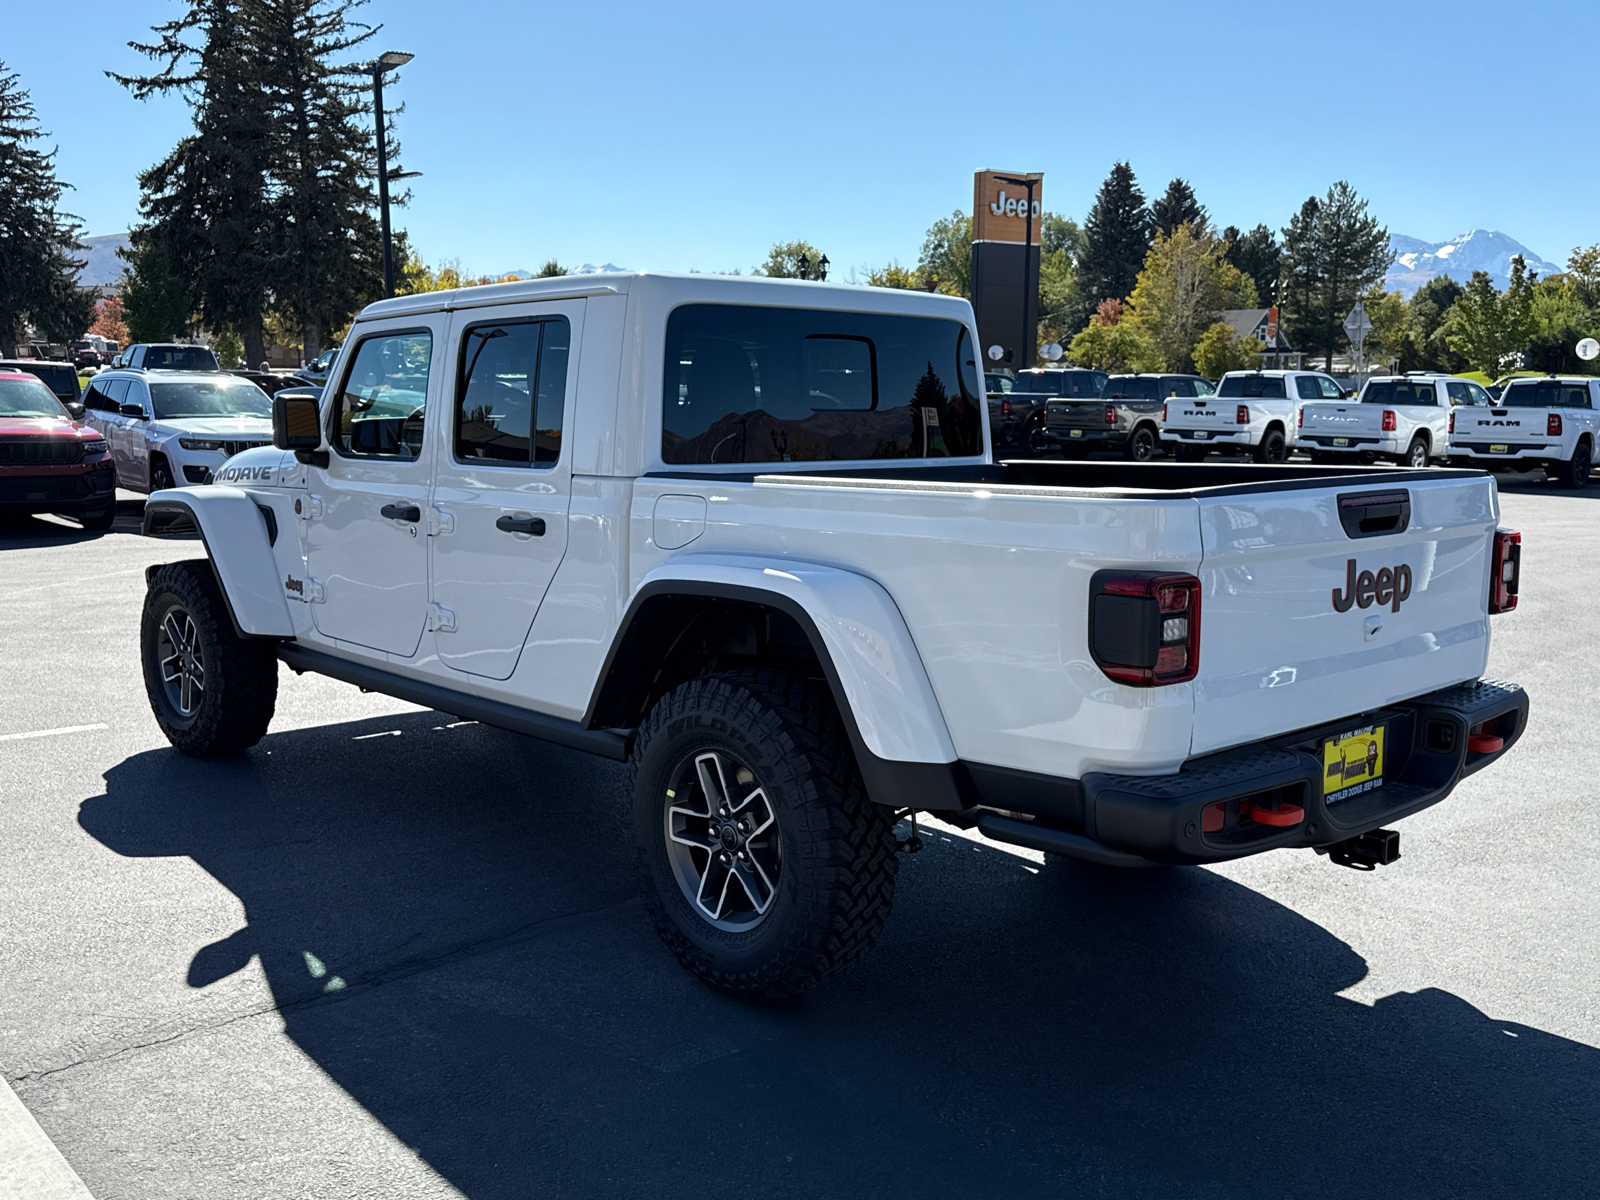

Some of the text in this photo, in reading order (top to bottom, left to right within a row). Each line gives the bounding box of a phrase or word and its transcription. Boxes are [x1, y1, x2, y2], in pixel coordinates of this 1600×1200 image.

[990, 190, 1040, 219] Jeep
[215, 466, 272, 483] MOJAVE
[1332, 558, 1412, 613] Jeep
[1340, 725, 1374, 740] KARL MALONE
[1369, 745, 1376, 755] 32
[1326, 777, 1383, 804] CHRYSLER DODGE JEEP RAM
